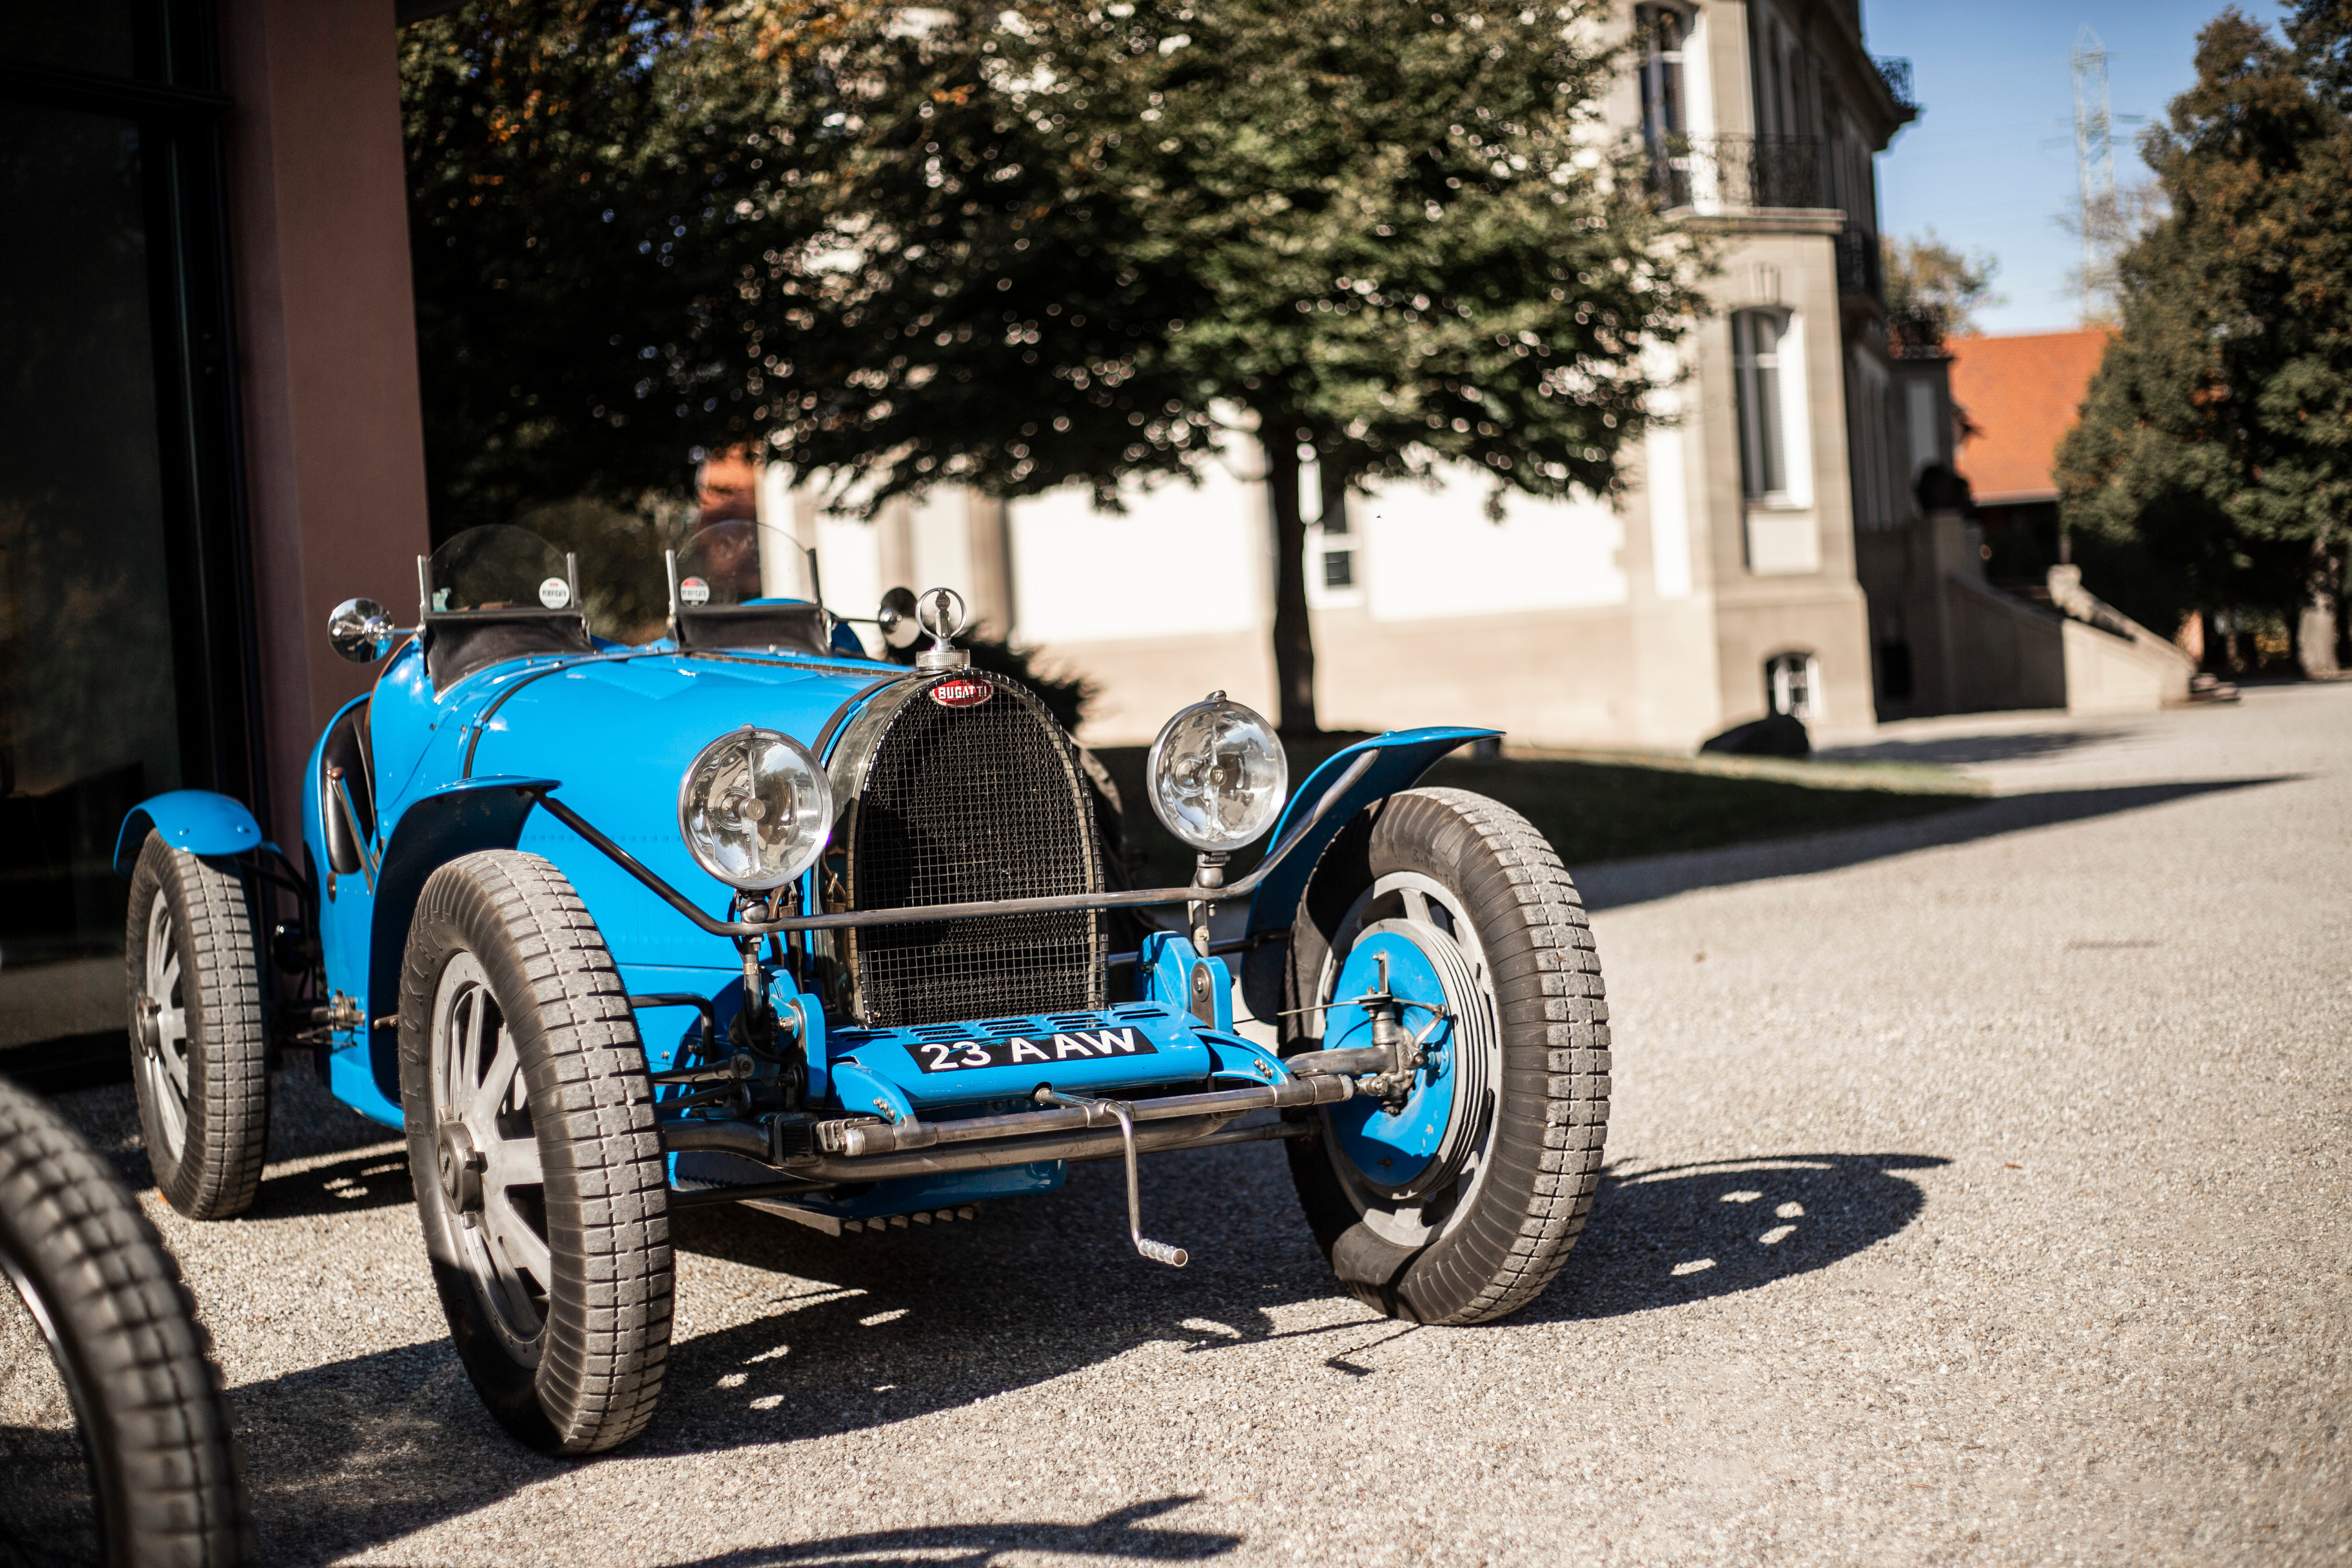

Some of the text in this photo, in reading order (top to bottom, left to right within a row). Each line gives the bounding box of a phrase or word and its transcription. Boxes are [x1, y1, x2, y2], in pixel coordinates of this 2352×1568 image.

[938, 685, 987, 700] BUGATTI
[921, 1028, 1136, 1070] 23 AAW
